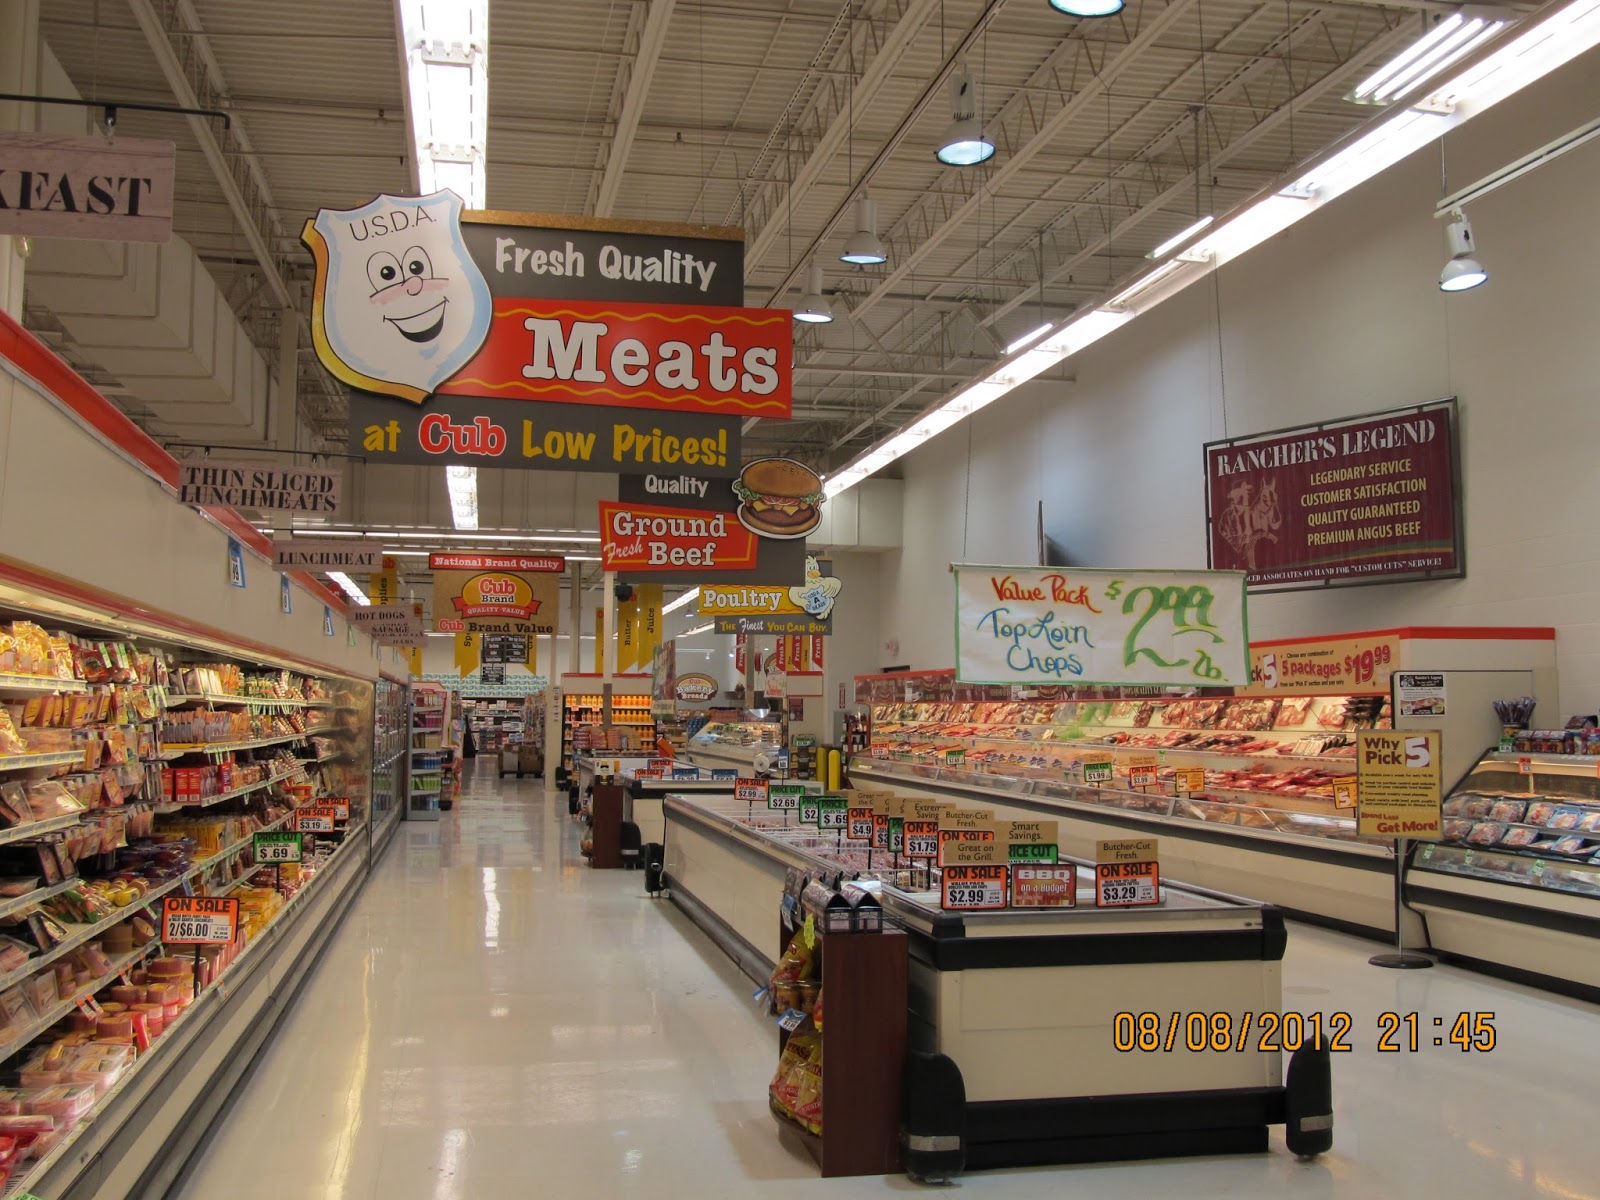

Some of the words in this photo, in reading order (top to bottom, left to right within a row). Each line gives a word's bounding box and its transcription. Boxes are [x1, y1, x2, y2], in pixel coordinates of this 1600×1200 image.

[0, 170, 152, 216] FAST
[349, 205, 437, 242] U.S.D.A.
[496, 238, 585, 277] Fresh
[599, 244, 717, 292] Quality
[523, 317, 779, 395] Meats
[363, 420, 403, 453] at
[418, 413, 507, 457] Cub
[523, 419, 597, 461] Low
[613, 425, 729, 468] Prices!
[1217, 436, 1337, 476] RANCHER'S
[1341, 419, 1436, 457] LEGEND
[1310, 463, 1366, 486] LEGENDARY
[1368, 458, 1412, 477] SERVICE
[187, 467, 244, 488] THIN
[252, 472, 334, 493] SLICED
[645, 474, 709, 499] Quality
[181, 485, 337, 512] LUNCHMEATS
[1301, 487, 1352, 507] CUSTOMER
[1353, 477, 1427, 500] SATISFACTION
[1307, 507, 1349, 527] QUALITY
[1350, 499, 1421, 521] GUARANTEED
[613, 511, 728, 537] Ground
[1307, 525, 1355, 546] PREMIUM
[1356, 523, 1393, 540] ANGUS
[1395, 521, 1422, 536] BEEF
[603, 536, 644, 564] Fresh
[647, 541, 717, 566] Beef
[279, 551, 375, 565] LUNCHMEAT
[434, 556, 482, 567] National
[485, 558, 517, 568] Brand
[519, 559, 559, 570] Quality
[1263, 570, 1303, 581] ASSOCIATES
[1314, 567, 1335, 577] HAND
[1336, 566, 1350, 574] FOR
[478, 577, 517, 595] Cub
[481, 595, 515, 604] Brand
[703, 589, 783, 611] Poultry
[990, 575, 1046, 603] Value
[1040, 573, 1103, 614] Pack
[355, 612, 376, 621] HOT
[379, 611, 405, 620] DOGS
[467, 607, 499, 615] QUALITY
[502, 608, 526, 616] VALUE
[439, 618, 466, 631] Cub
[468, 622, 511, 633] Brand
[515, 622, 554, 634] Value
[624, 618, 632, 646] Butter
[720, 621, 736, 631] THE
[739, 618, 764, 633] Finest
[767, 622, 785, 632] YOU
[786, 623, 805, 633] CAN
[976, 607, 1029, 646] Top
[1029, 610, 1095, 650] Loin
[1006, 644, 1084, 678] Chops
[1263, 653, 1278, 689] 5
[1282, 660, 1289, 676] 5
[1290, 660, 1341, 679] packages
[676, 684, 715, 696] Bakery
[1364, 737, 1400, 751] Why
[1365, 750, 1402, 765] Pick
[1404, 736, 1430, 768] 5
[771, 786, 789, 794] PRICE
[789, 786, 801, 794] CUT
[773, 798, 795, 808] $2.69
[821, 800, 841, 808] PRICE
[851, 810, 866, 818] ON
[916, 811, 939, 822] Saving
[946, 811, 988, 820] Butcher-Cut
[300, 822, 321, 830] $3.19
[853, 825, 872, 836] $4.9
[907, 823, 924, 833] ON
[1012, 821, 1040, 831] Smart
[1376, 822, 1401, 833] Get
[1402, 820, 1438, 833] More!
[258, 833, 281, 842] PRICE
[283, 833, 298, 841] CUT
[942, 831, 960, 841] ON
[962, 832, 989, 841] SALE
[1009, 831, 1043, 843] Savings.
[909, 841, 937, 852] $1.79
[957, 843, 981, 852] Great
[1009, 844, 1028, 858] RICE
[1030, 844, 1050, 857] CUT
[1103, 842, 1151, 851] Butcher-Cut
[958, 852, 972, 861] the
[973, 852, 993, 862] Grill.
[947, 866, 965, 879] ON
[970, 866, 1001, 879] SALE
[1018, 869, 1070, 883] BBQ
[1100, 864, 1120, 878] ON
[1122, 862, 1153, 877] SALE
[1020, 883, 1031, 892] on
[1033, 884, 1038, 892] a
[1040, 883, 1068, 894] Budget
[1103, 887, 1136, 901] $3.29
[950, 889, 984, 903] $2.99
[168, 898, 192, 911] ON
[195, 899, 230, 912] SALE
[169, 922, 209, 938] 2/$6.00
